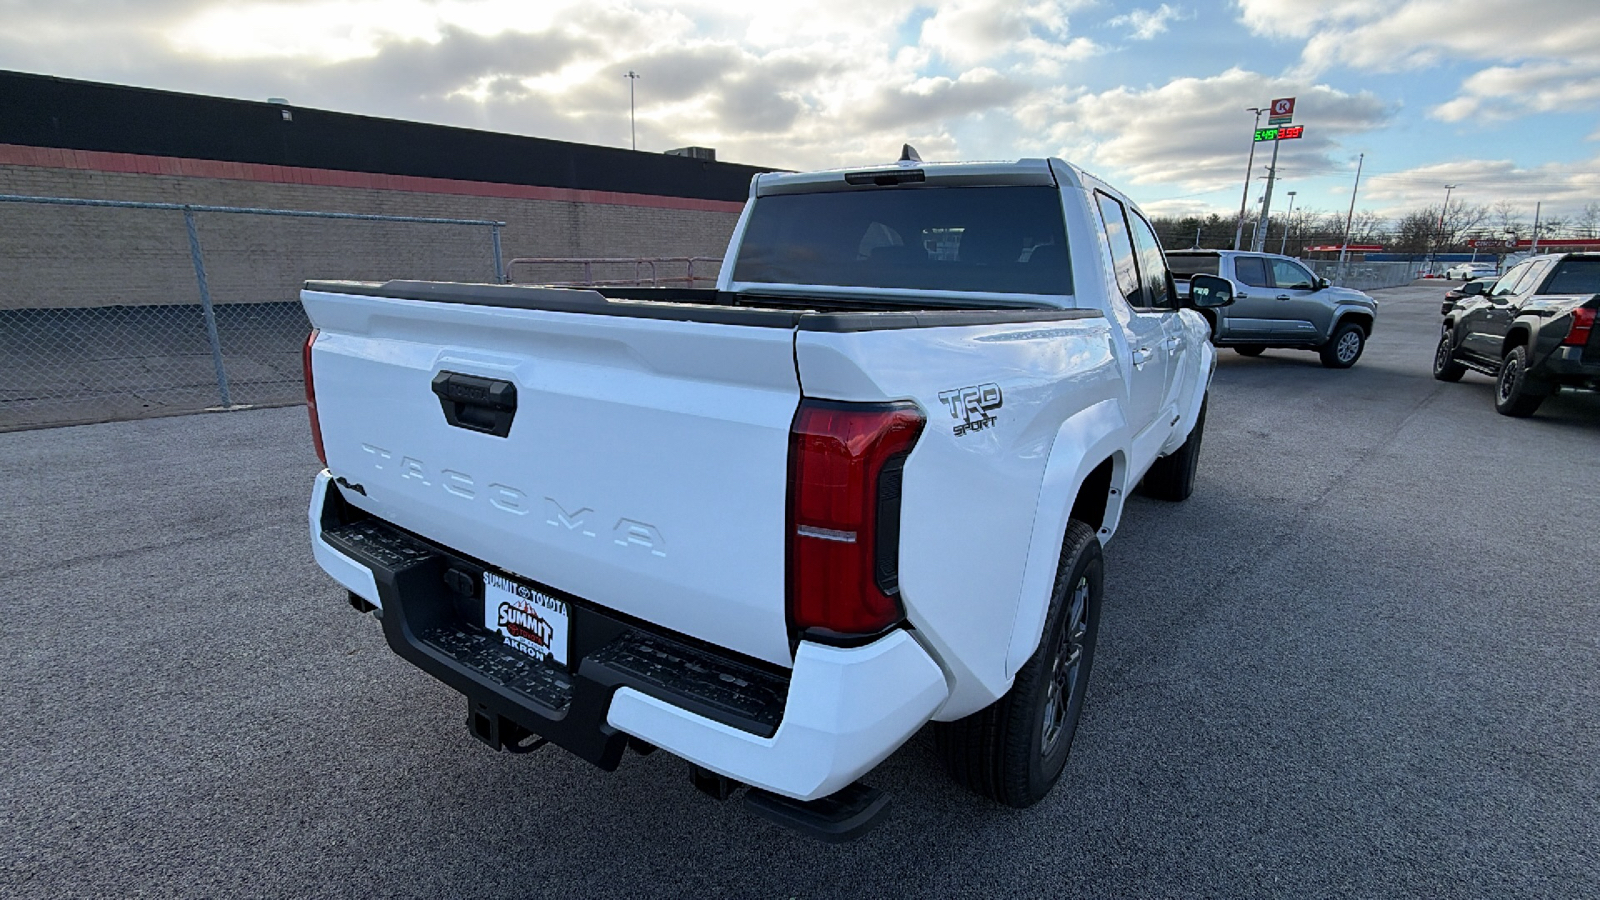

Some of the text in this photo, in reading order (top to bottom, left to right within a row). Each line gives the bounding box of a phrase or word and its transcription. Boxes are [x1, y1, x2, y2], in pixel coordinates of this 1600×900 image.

[1278, 101, 1289, 113] K
[938, 382, 1003, 423] TRD
[953, 416, 997, 437] SPORT
[362, 443, 666, 557] TACOMA
[483, 571, 567, 617] SUMMIT TOYOTA
[498, 603, 553, 648] SUMMIT
[503, 637, 544, 661] AKRON
